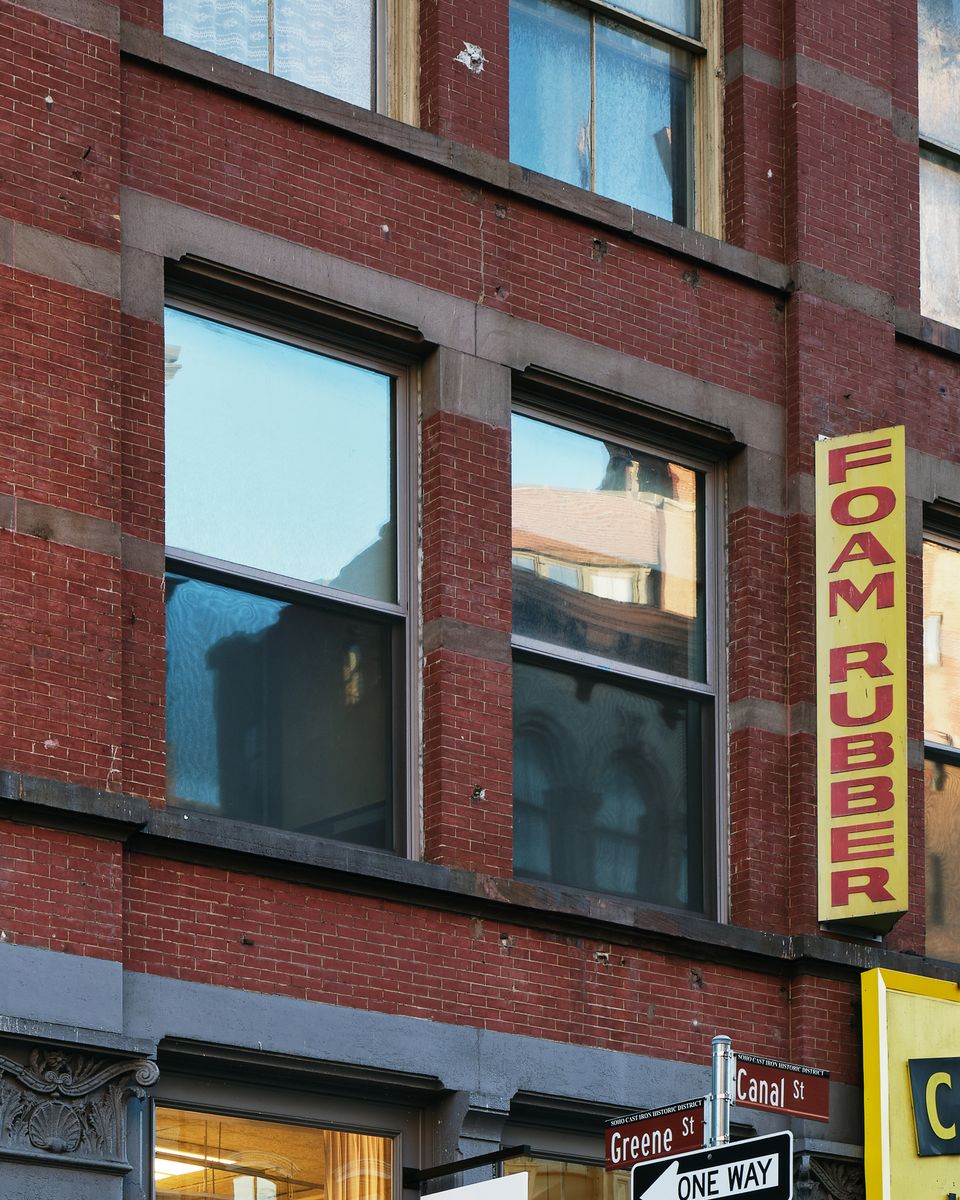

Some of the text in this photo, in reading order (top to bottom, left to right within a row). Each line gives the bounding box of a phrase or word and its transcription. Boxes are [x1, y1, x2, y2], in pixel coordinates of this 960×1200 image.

[828, 438, 897, 908] FOAM RUBBER
[765, 1059, 778, 1068] IRON
[778, 1061, 802, 1073] HISTORIC
[801, 1066, 824, 1077] DISTRICT
[737, 1067, 805, 1108] Canal St
[610, 1099, 703, 1127] SOHO CAST IRON HISTORIC DISTRICT
[610, 1115, 695, 1164] Greene St
[727, 1157, 774, 1192] WAY
